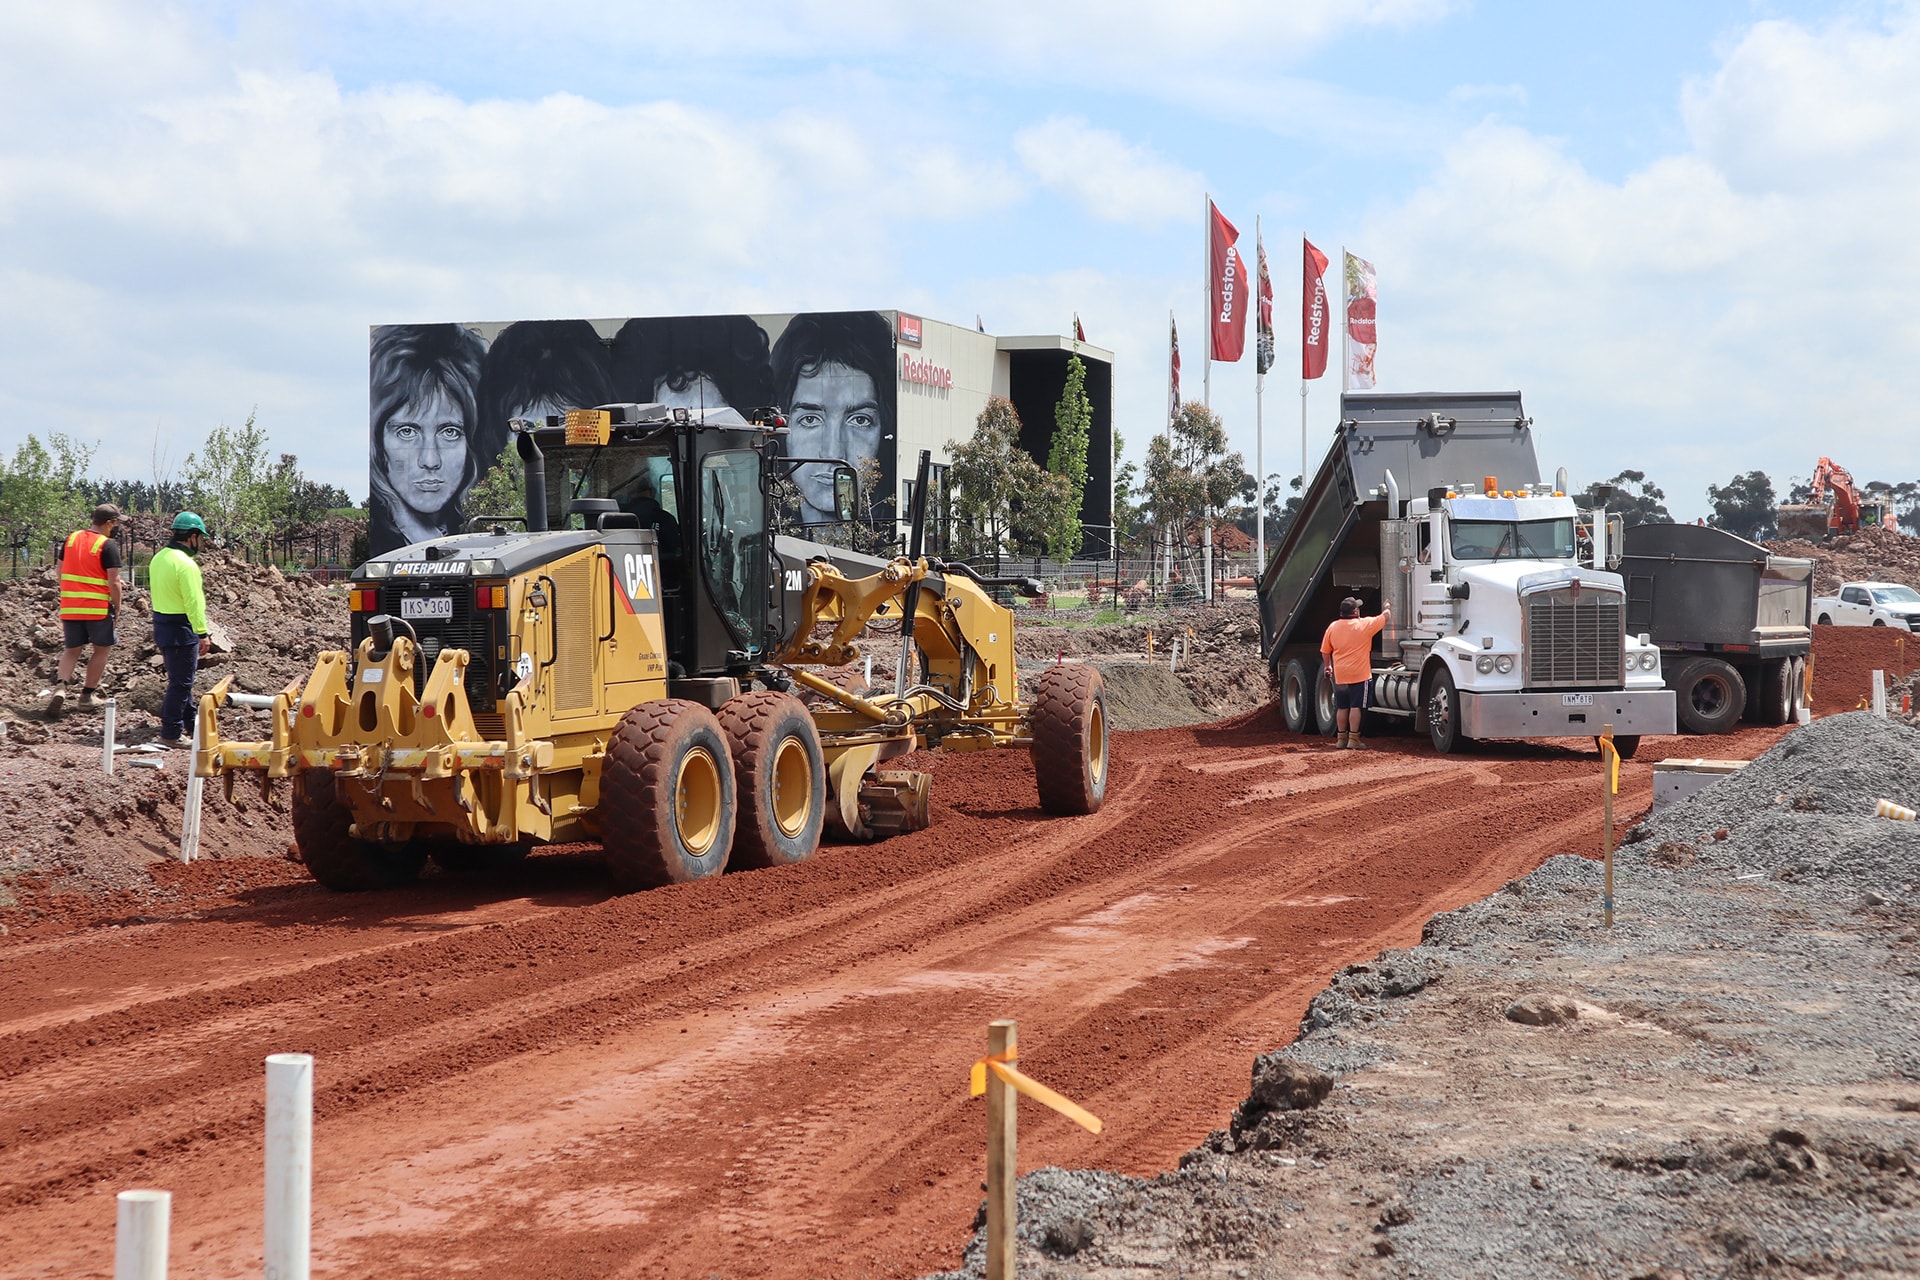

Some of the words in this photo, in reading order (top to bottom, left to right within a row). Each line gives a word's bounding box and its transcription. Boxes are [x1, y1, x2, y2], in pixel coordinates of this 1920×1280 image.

[1306, 276, 1324, 346] Redstone
[1350, 317, 1376, 325] Redston
[393, 561, 466, 575] CATERPILLAR
[624, 553, 654, 600] CAT
[784, 570, 802, 591] 2M
[404, 601, 423, 614] 1KS
